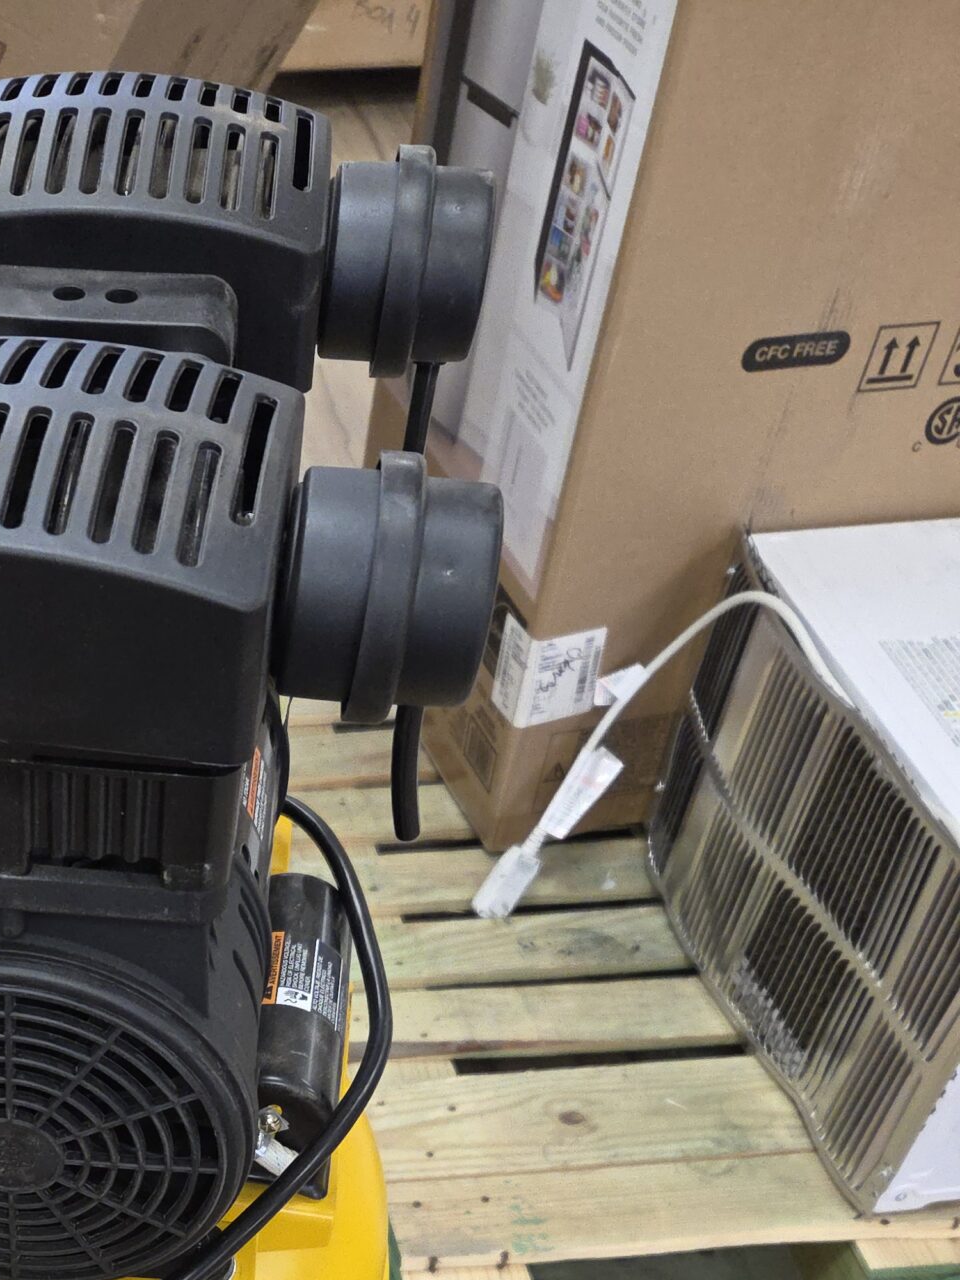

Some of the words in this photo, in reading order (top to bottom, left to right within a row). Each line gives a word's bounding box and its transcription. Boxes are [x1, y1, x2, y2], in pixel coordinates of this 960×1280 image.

[755, 340, 788, 363] CFC
[793, 336, 841, 359] FREE
[269, 935, 281, 984] AVERTISSEMENT
